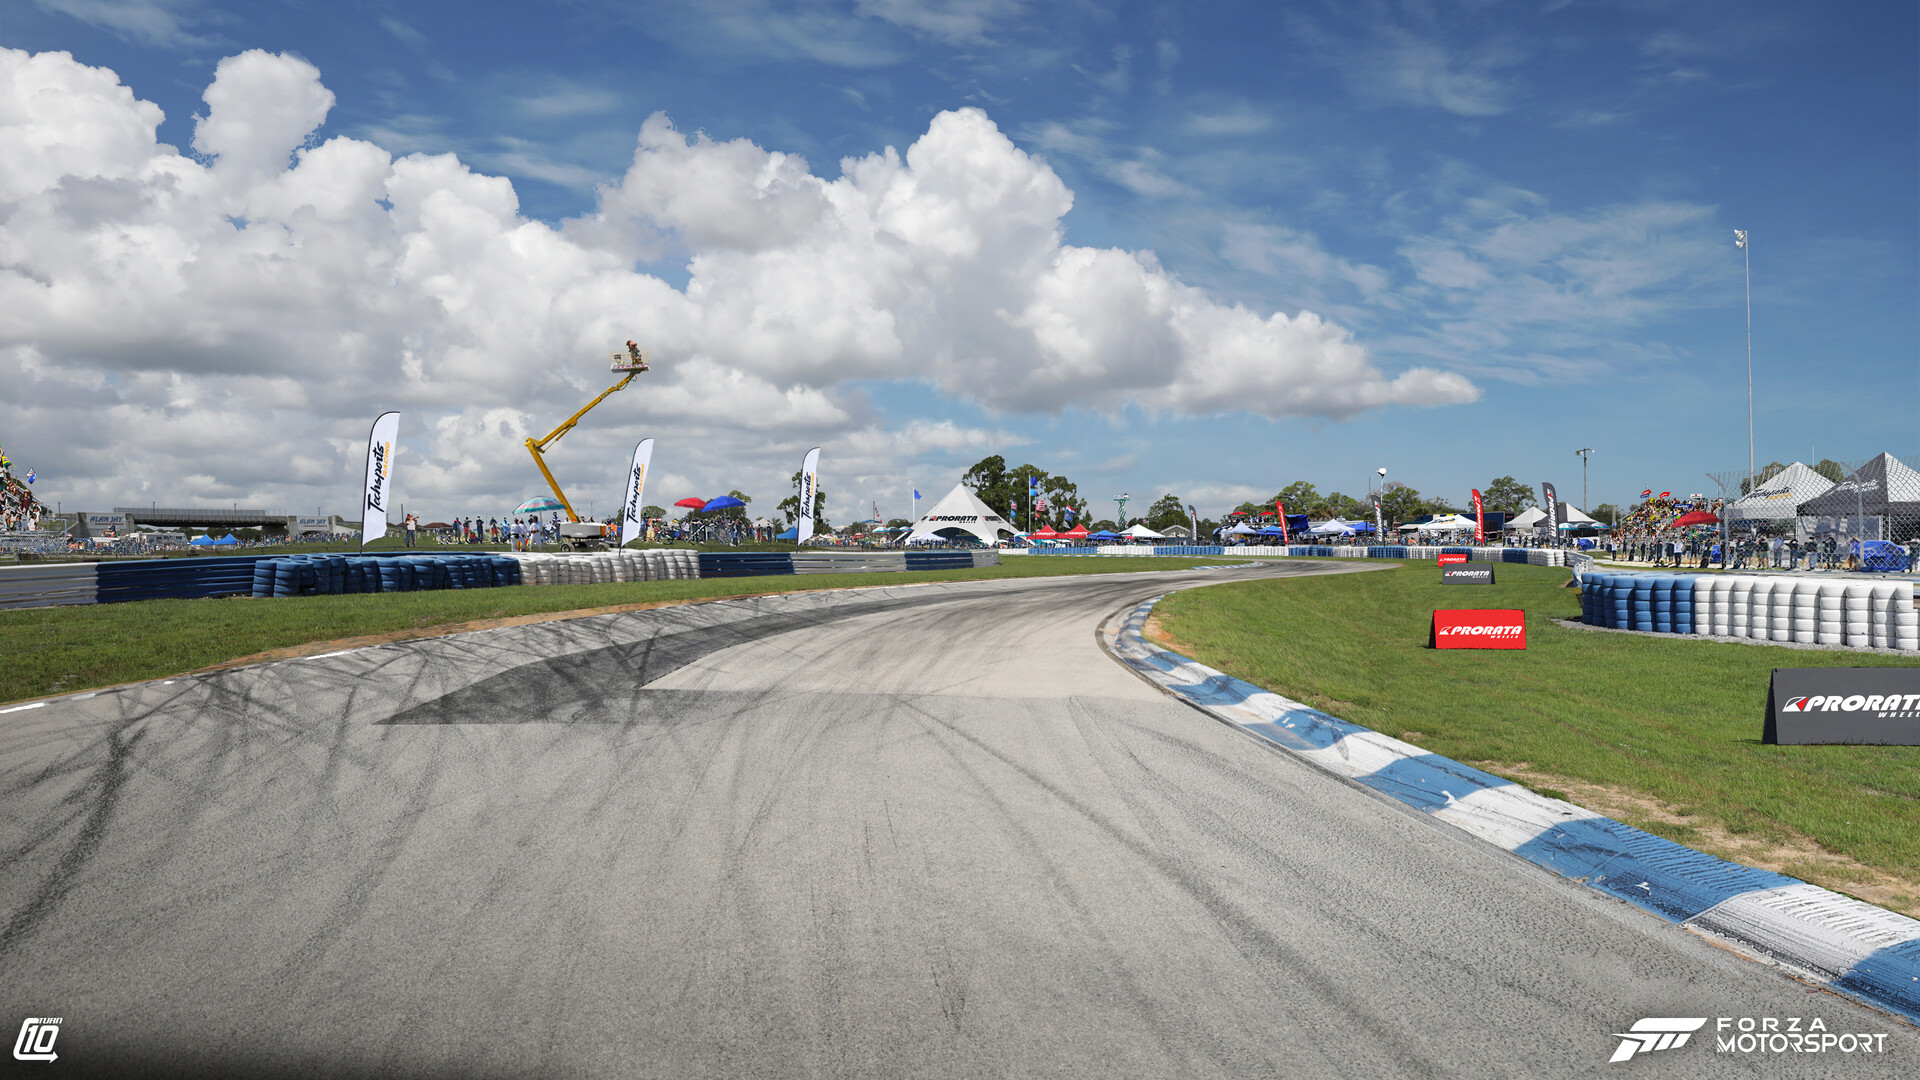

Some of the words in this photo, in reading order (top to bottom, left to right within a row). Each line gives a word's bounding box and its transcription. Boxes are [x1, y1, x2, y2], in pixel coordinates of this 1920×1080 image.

[382, 441, 391, 478] RACING
[367, 441, 385, 513] Techsports
[1450, 625, 1523, 636] PRORATA
[1803, 694, 1920, 712] PRORAT
